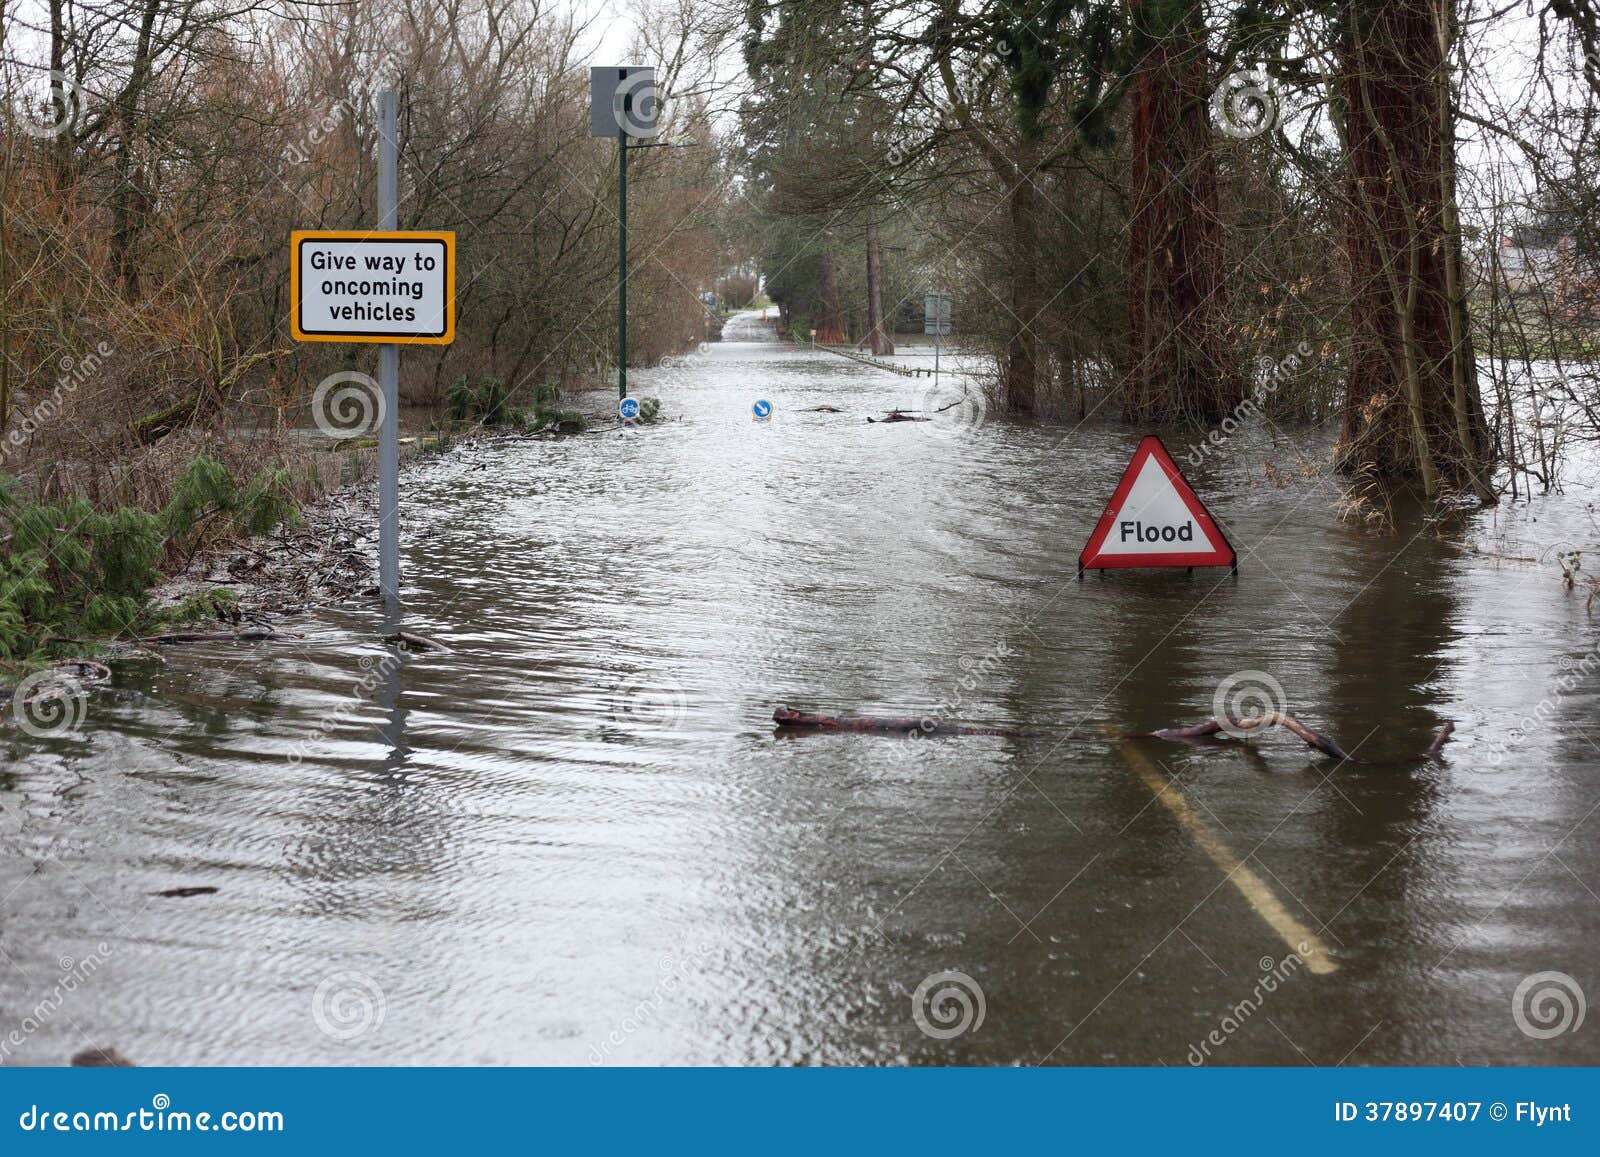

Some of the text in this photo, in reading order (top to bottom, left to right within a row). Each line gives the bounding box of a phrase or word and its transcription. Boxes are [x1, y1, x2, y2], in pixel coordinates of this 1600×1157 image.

[310, 250, 436, 275] Give way to
[321, 276, 423, 300] oncoming
[329, 301, 416, 321] vehicles
[1120, 520, 1193, 543] Flood
